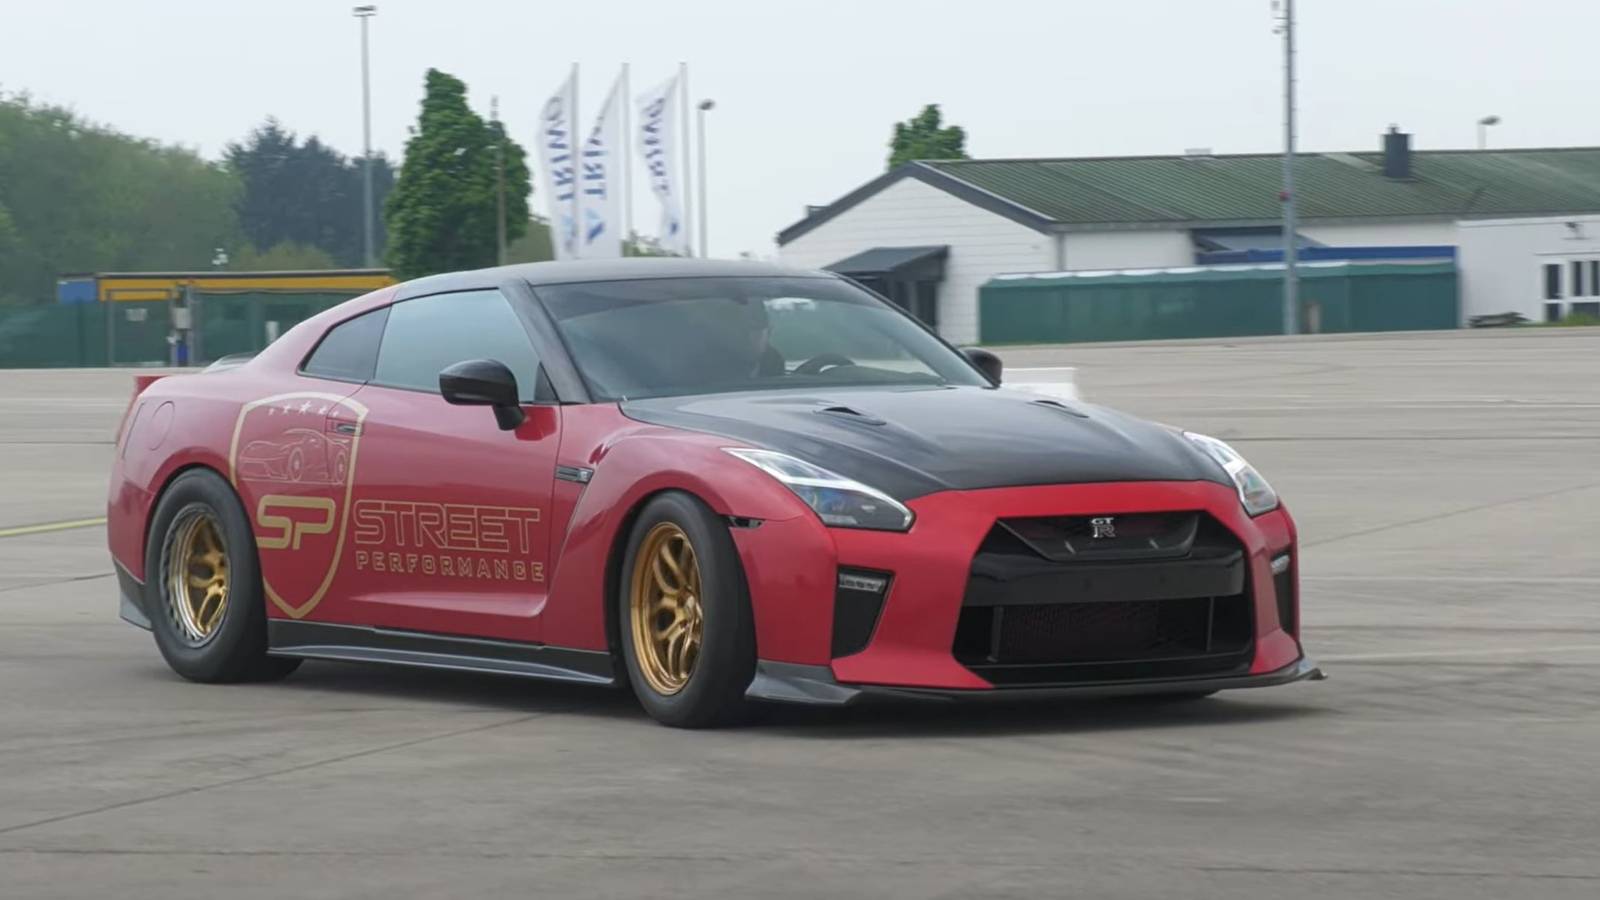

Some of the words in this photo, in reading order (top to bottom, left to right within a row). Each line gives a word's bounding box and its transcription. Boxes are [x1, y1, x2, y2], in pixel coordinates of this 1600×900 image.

[256, 495, 336, 550] SP
[353, 499, 541, 554] STREET
[355, 551, 545, 582] PERFORMANCE
